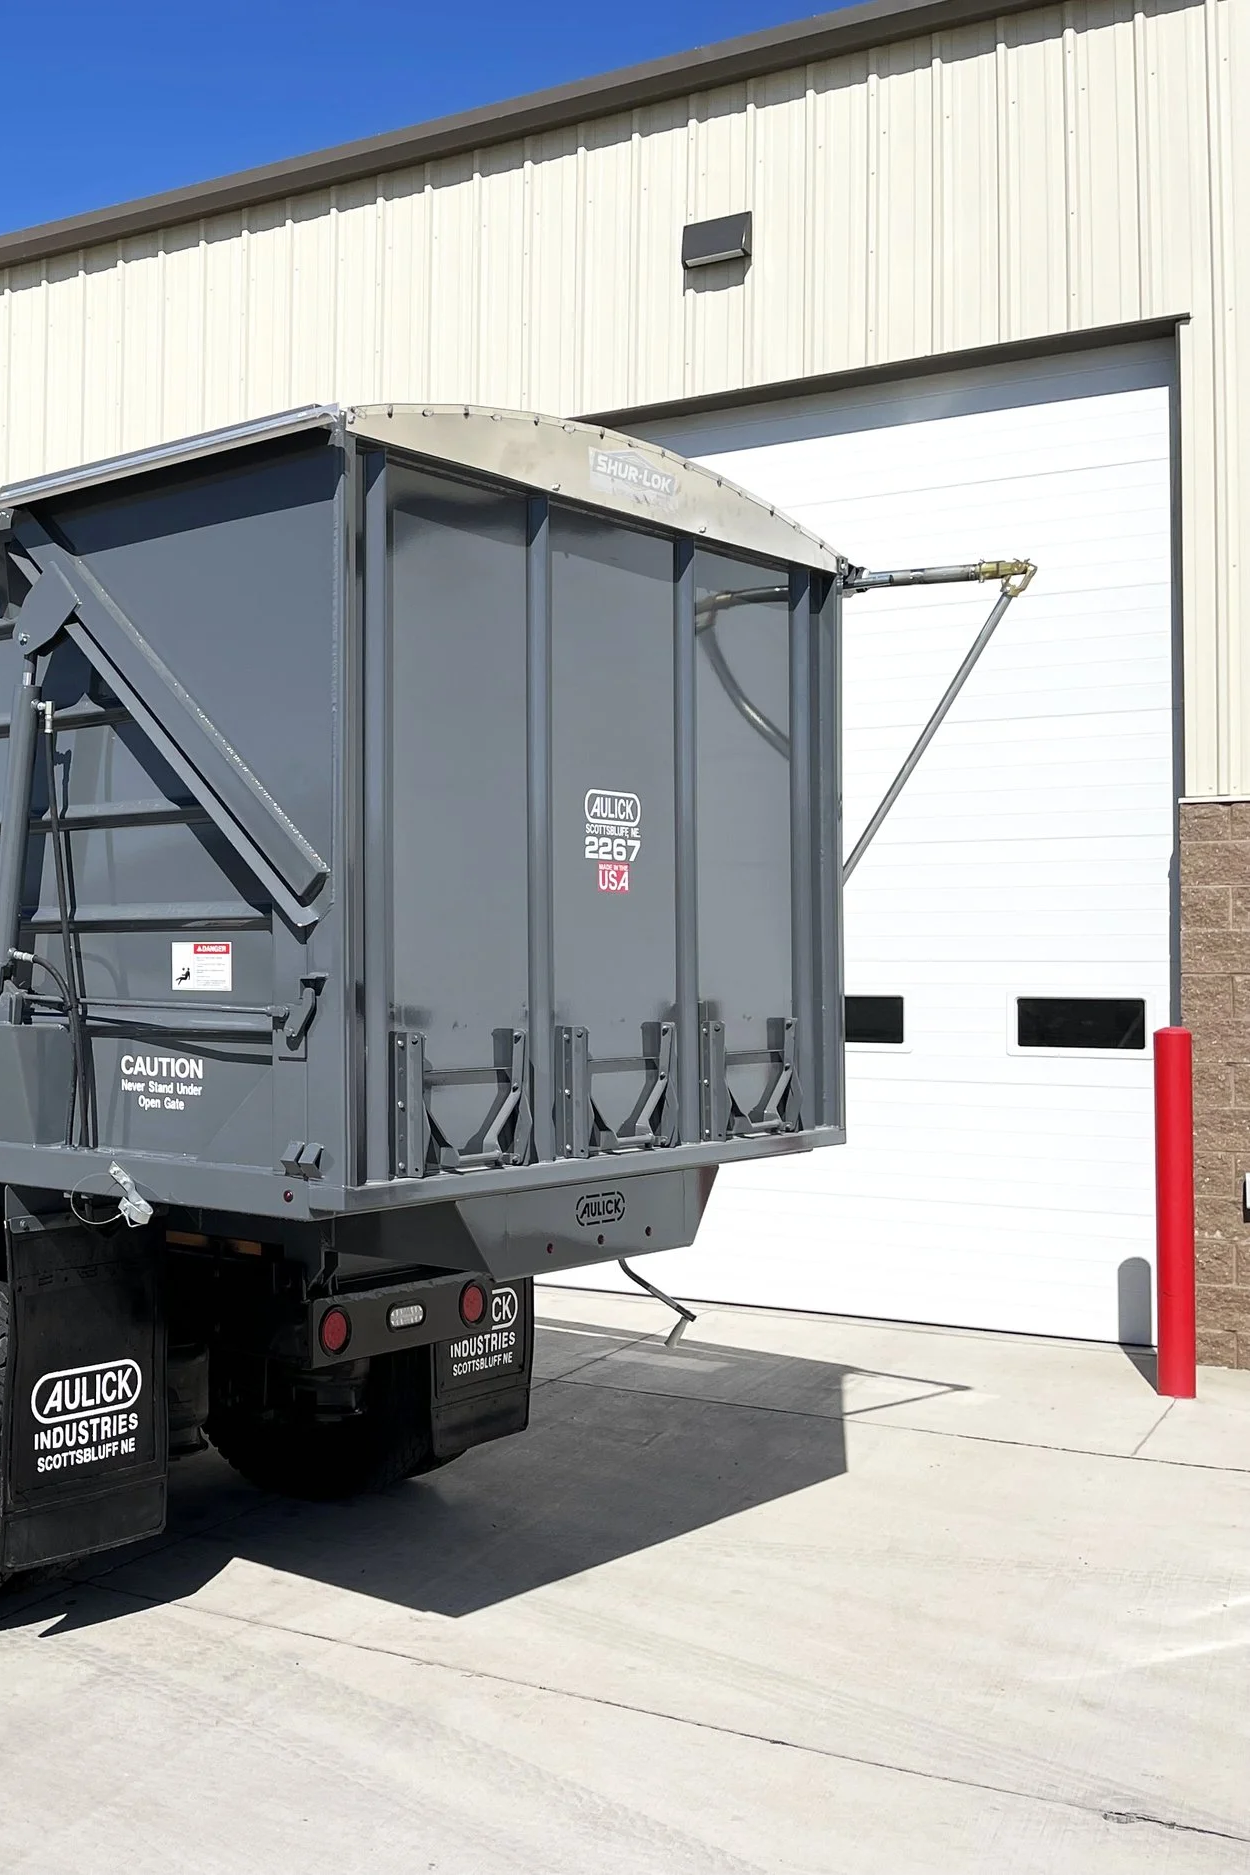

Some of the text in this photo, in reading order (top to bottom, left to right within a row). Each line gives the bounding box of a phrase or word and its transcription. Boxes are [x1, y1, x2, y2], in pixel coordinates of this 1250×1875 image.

[590, 796, 634, 820] AULICK
[584, 836, 641, 861] 2267
[598, 869, 629, 890] USA
[121, 1055, 204, 1079] CAUTION
[121, 1078, 203, 1096] Never Stand Under
[138, 1095, 185, 1111] Open Gate
[580, 1197, 622, 1219] AULICK
[450, 1331, 516, 1359] INDUSTRIES
[452, 1351, 514, 1377] SCOTTSBLUFF NE
[42, 1367, 133, 1415] AULICK
[34, 1412, 139, 1451] INDUSTRIES
[37, 1437, 136, 1473] SCOTTSBLUFF NE
